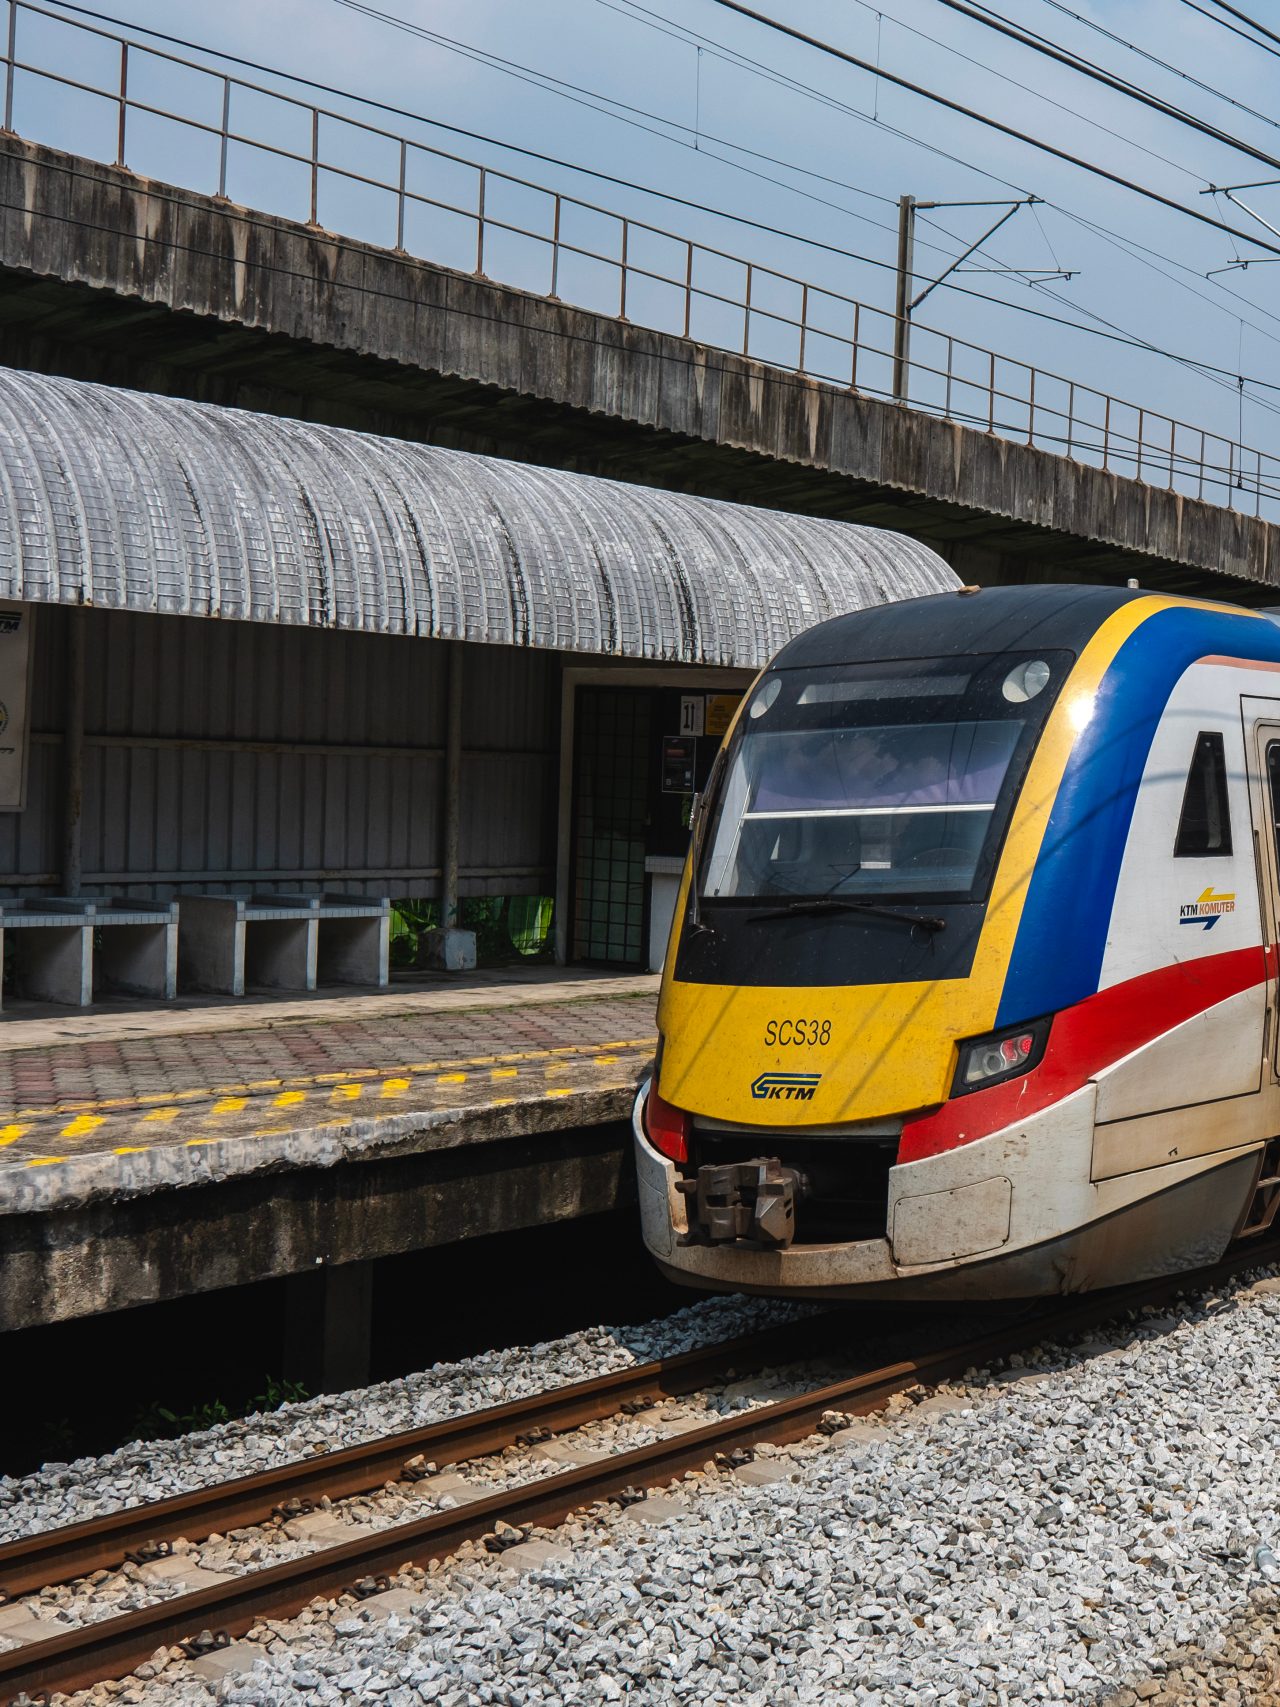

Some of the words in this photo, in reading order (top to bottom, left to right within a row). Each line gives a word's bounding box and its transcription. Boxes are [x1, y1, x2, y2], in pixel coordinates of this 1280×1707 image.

[1180, 904, 1198, 917] KTM
[1199, 901, 1235, 916] KOMUTER
[764, 1019, 832, 1047] SCS38
[768, 1086, 816, 1100] KTM
